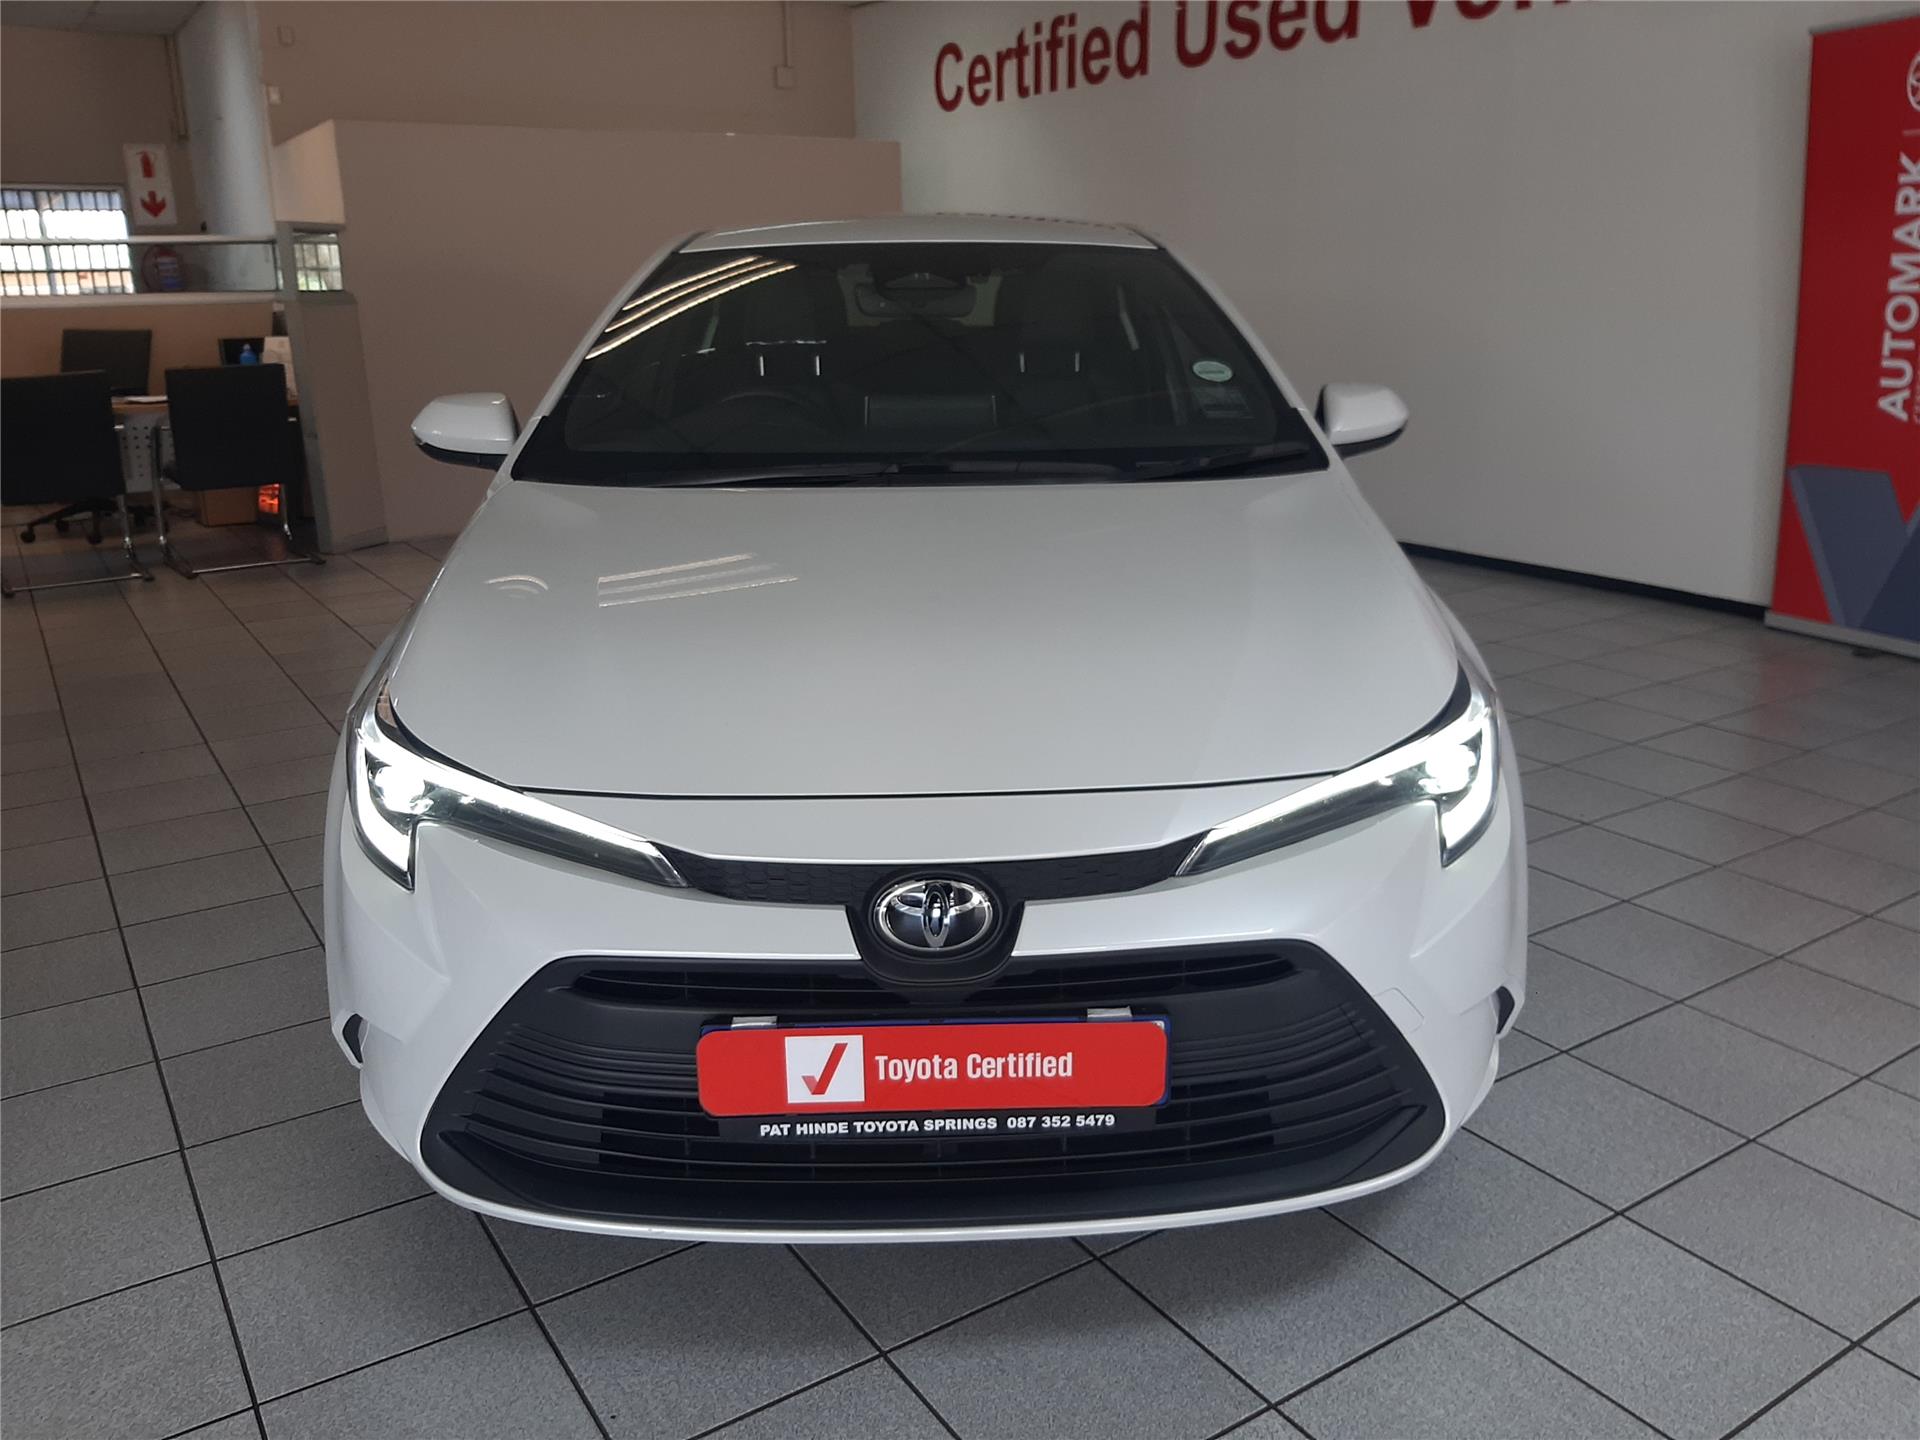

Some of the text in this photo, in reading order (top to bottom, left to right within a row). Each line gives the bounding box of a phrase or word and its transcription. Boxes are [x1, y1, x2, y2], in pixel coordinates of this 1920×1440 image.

[934, 0, 1149, 112] Certified
[1877, 151, 1920, 422] AUTOMARK
[875, 1051, 1073, 1082] Toyota Certified
[760, 1114, 1115, 1136] PAT HINDE TOYOTA SPRINGS 087 352 5479
